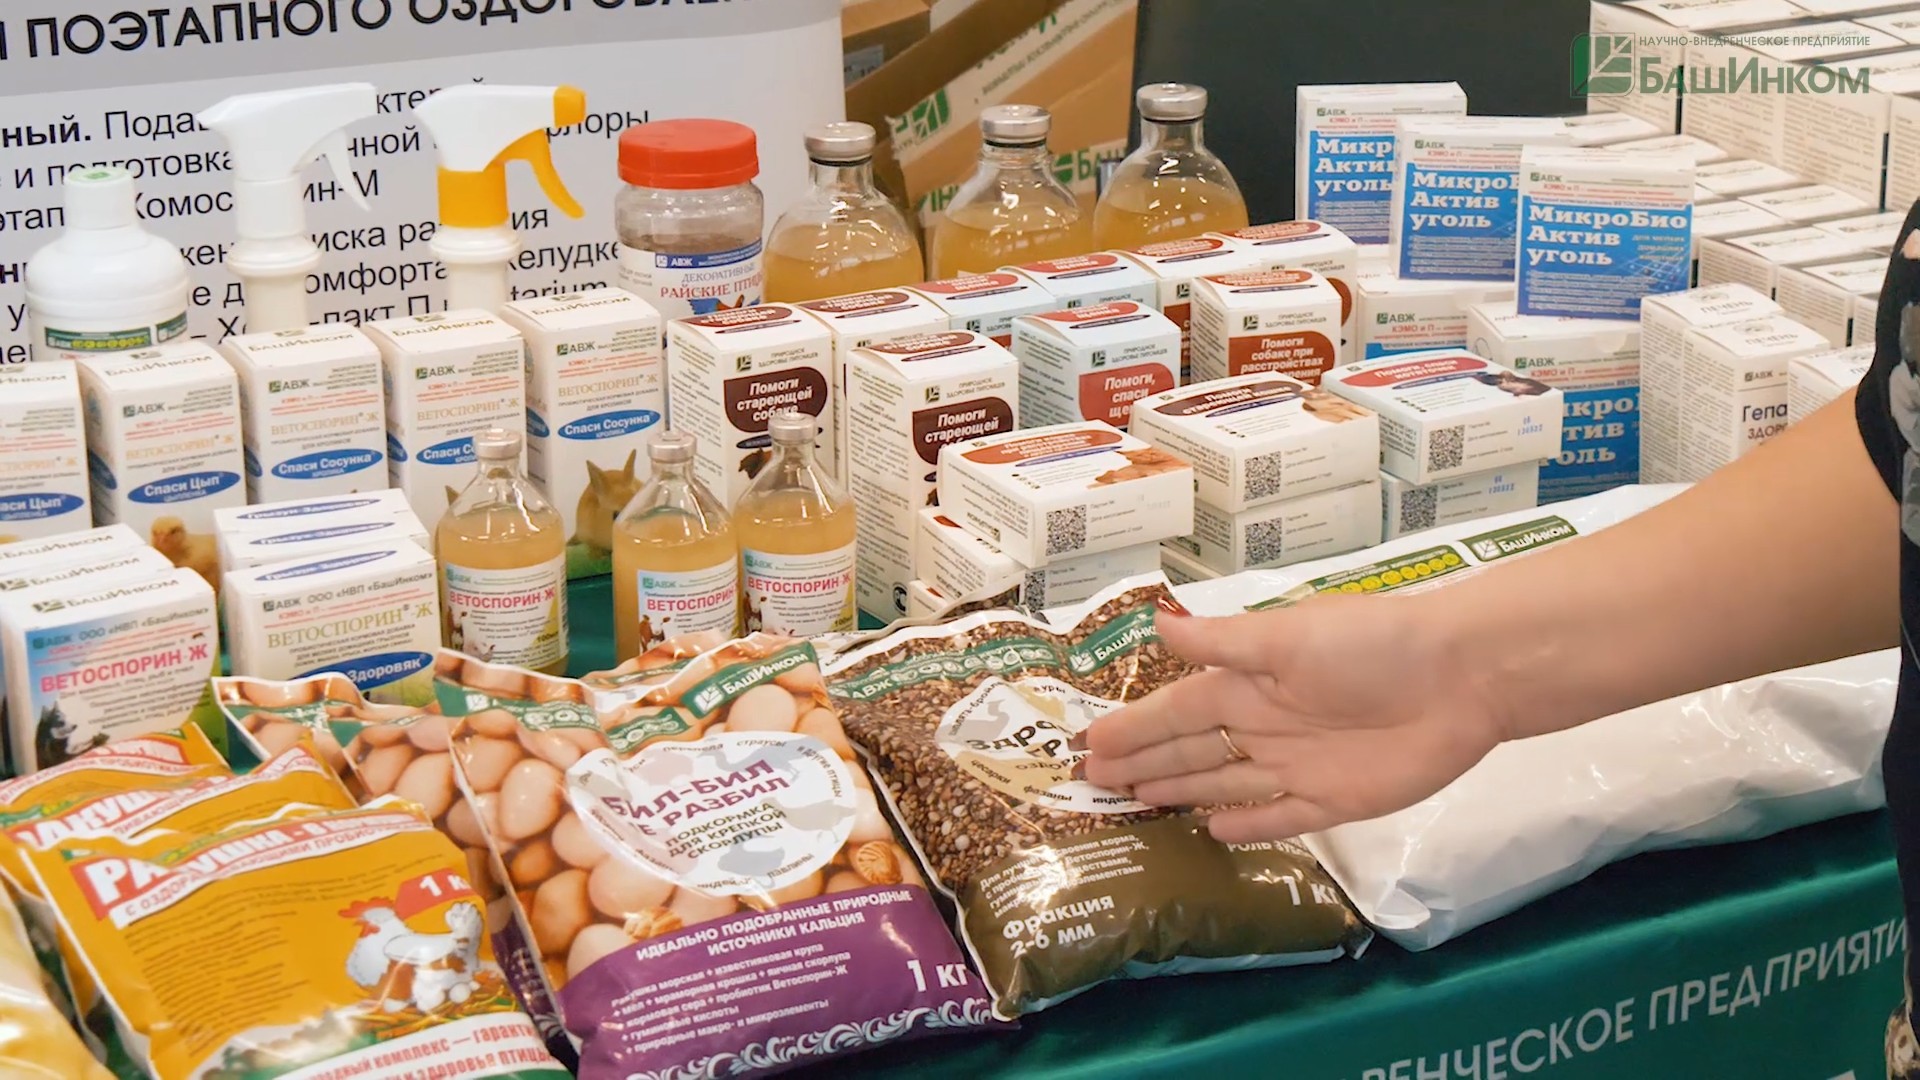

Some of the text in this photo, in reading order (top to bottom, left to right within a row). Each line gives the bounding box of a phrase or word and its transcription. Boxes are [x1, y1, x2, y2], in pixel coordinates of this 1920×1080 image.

[27, 0, 392, 58] ПОЭТАПНОГО
[2, 114, 91, 148] ный.
[1317, 138, 1395, 158] Микр
[1410, 191, 1499, 209] Актив
[1410, 213, 1491, 231] уголь
[1528, 205, 1687, 229] МикроБио
[1527, 225, 1620, 246] Актив
[671, 258, 694, 267] АВЖ
[1527, 248, 1613, 266] уголь
[660, 282, 731, 299] РАЙСКИЕ
[1389, 313, 1416, 324] АВЖ
[570, 341, 596, 353] АВЖ
[1261, 337, 1304, 350] Помоги
[1252, 348, 1314, 362] собаке при
[1528, 357, 1555, 368] АВЖ
[429, 365, 456, 377] АВЖ
[1240, 357, 1325, 374] расстройствах
[282, 378, 311, 391] АВЖ
[749, 378, 800, 396] Помоги
[1104, 373, 1156, 391] Помоги,
[737, 386, 813, 411] стареющей
[136, 402, 165, 417] АВЖ
[938, 408, 987, 428] Помоги
[1742, 403, 1788, 422] Гепа
[564, 413, 650, 435] Спаси Сосунка
[925, 417, 1000, 443] стареющей
[1564, 422, 1625, 441] тив
[423, 447, 461, 460] Спаси
[278, 453, 372, 475] Спаси Сосунка
[145, 480, 187, 497] Спаси
[307, 592, 333, 604] ООО
[348, 656, 421, 684] Здоровяк
[600, 759, 775, 819] БИЛ-БИЛ
[662, 777, 790, 827] РАЗБИЛ
[665, 802, 776, 848] ПОДКОРМКА
[669, 808, 787, 858] ДЛЯ КРЕПКОЙ
[687, 822, 783, 860] СКОРЛУПЫ
[979, 874, 1001, 892] Для
[1101, 834, 1140, 848] корма,
[420, 875, 442, 897] 1
[1281, 876, 1302, 906] 1
[636, 889, 913, 961] ИДЕАЛЬНО ПОДОБРАННЫЕ ПРИРОДНЫЕ
[1002, 895, 1115, 940] Фракция
[707, 911, 865, 956] ИСТОЧНИКИ КАЛЬЦИЯ
[1009, 923, 1096, 959] 2-6 мм
[794, 943, 824, 959] крупа
[804, 951, 851, 969] скорлупа
[907, 961, 971, 992] 1 кг
[1650, 916, 1907, 1030] ПРЕДПРИЯТИ
[715, 983, 772, 1004] пробиотик
[772, 965, 848, 989] Ветоспорин-Ж
[692, 1005, 740, 1023] кислоты
[746, 1000, 829, 1026] микроэлементы
[374, 1023, 537, 1069] комплекс гаранти
